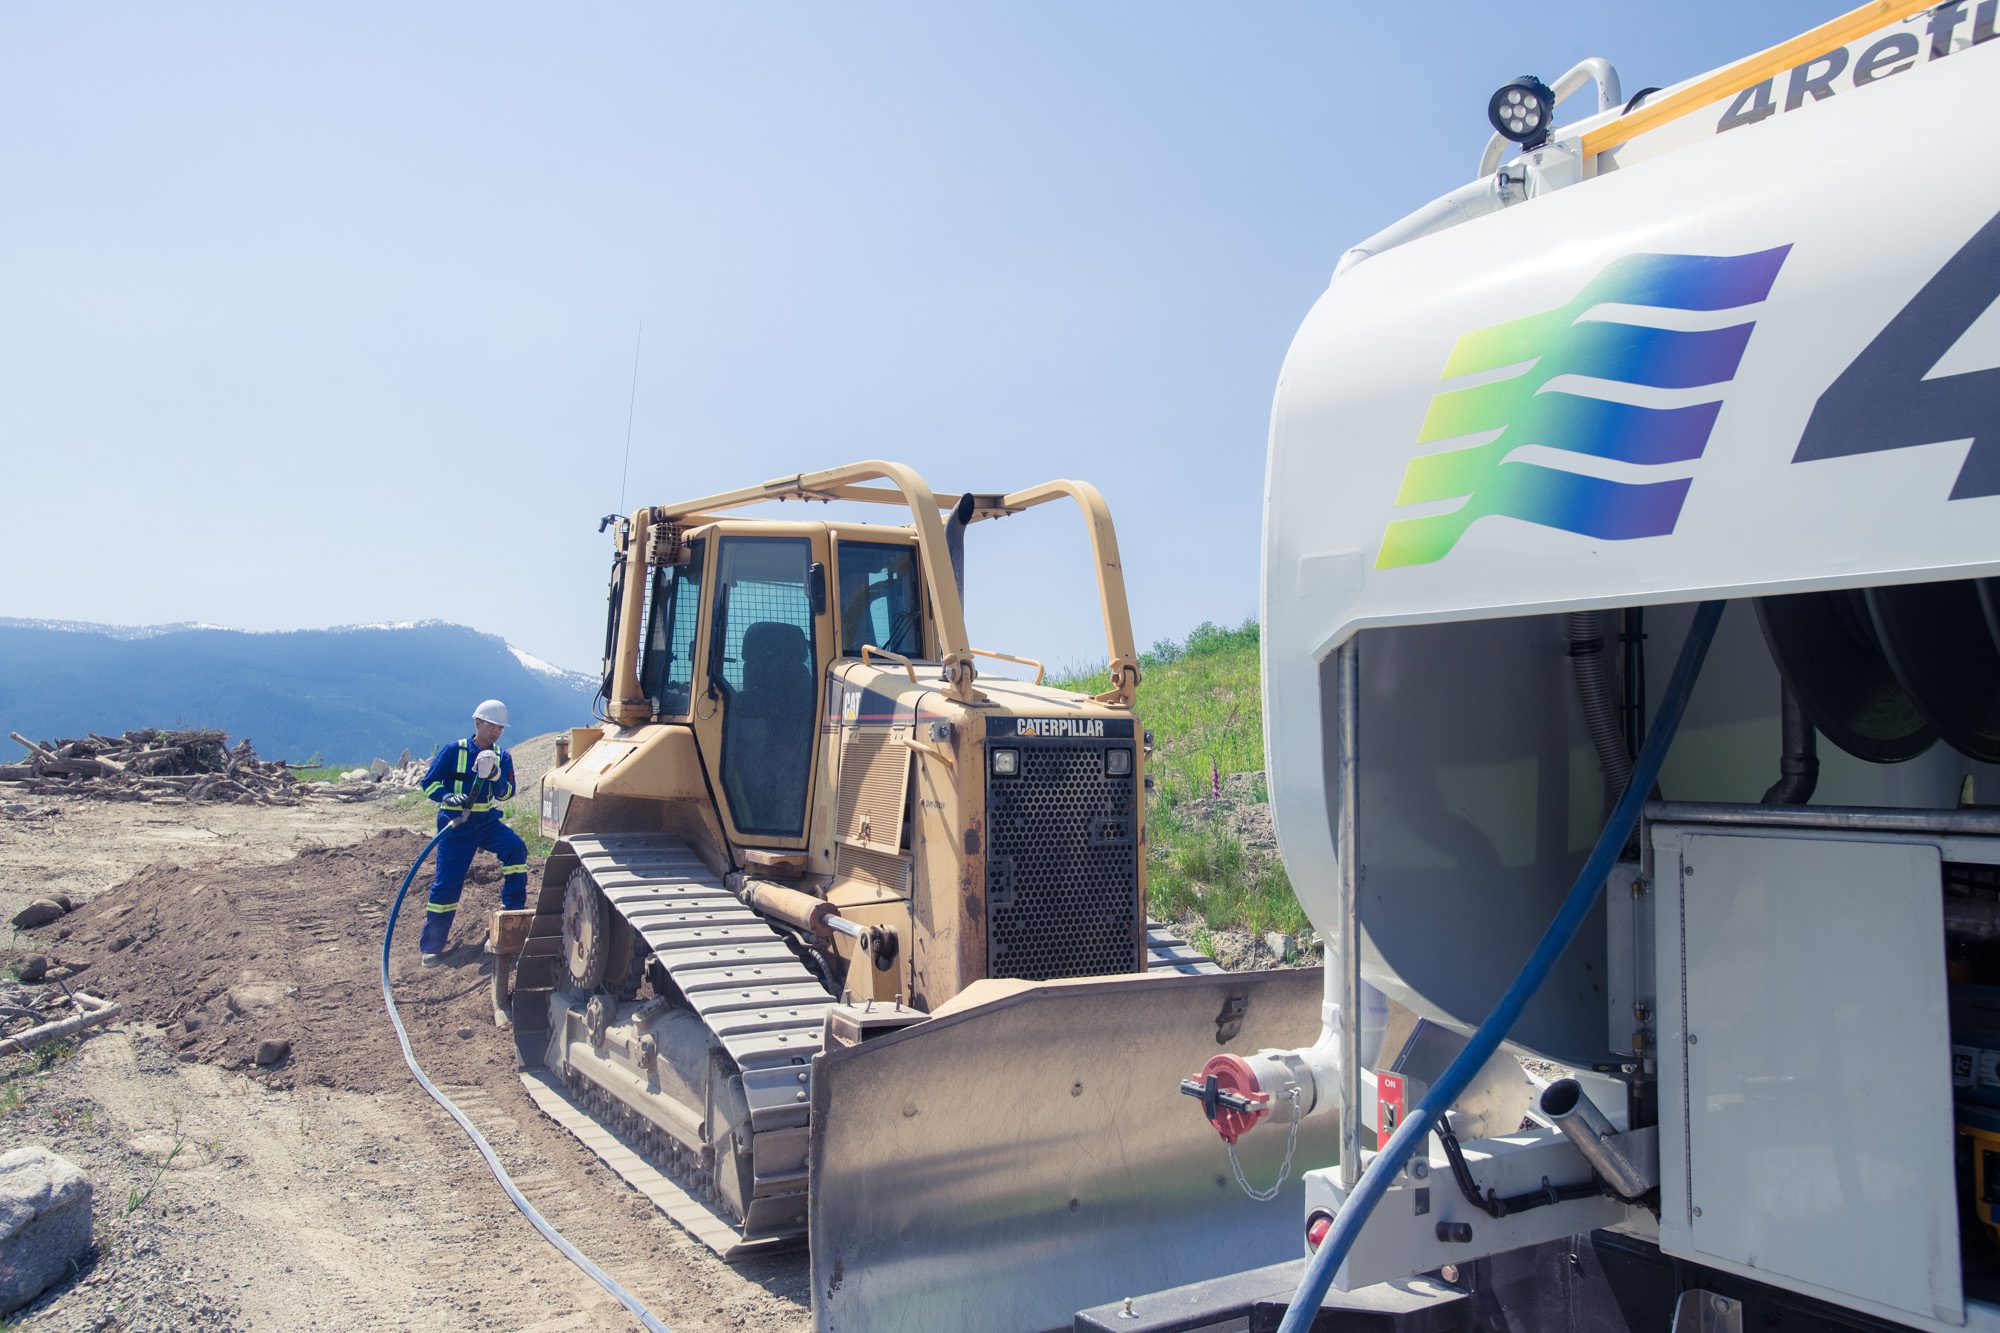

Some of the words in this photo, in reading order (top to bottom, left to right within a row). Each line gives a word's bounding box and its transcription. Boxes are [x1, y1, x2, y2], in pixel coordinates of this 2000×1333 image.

[843, 692, 861, 720] CAT
[1016, 718, 1104, 737] CATERPILLAR
[1384, 1079, 1396, 1088] ON
